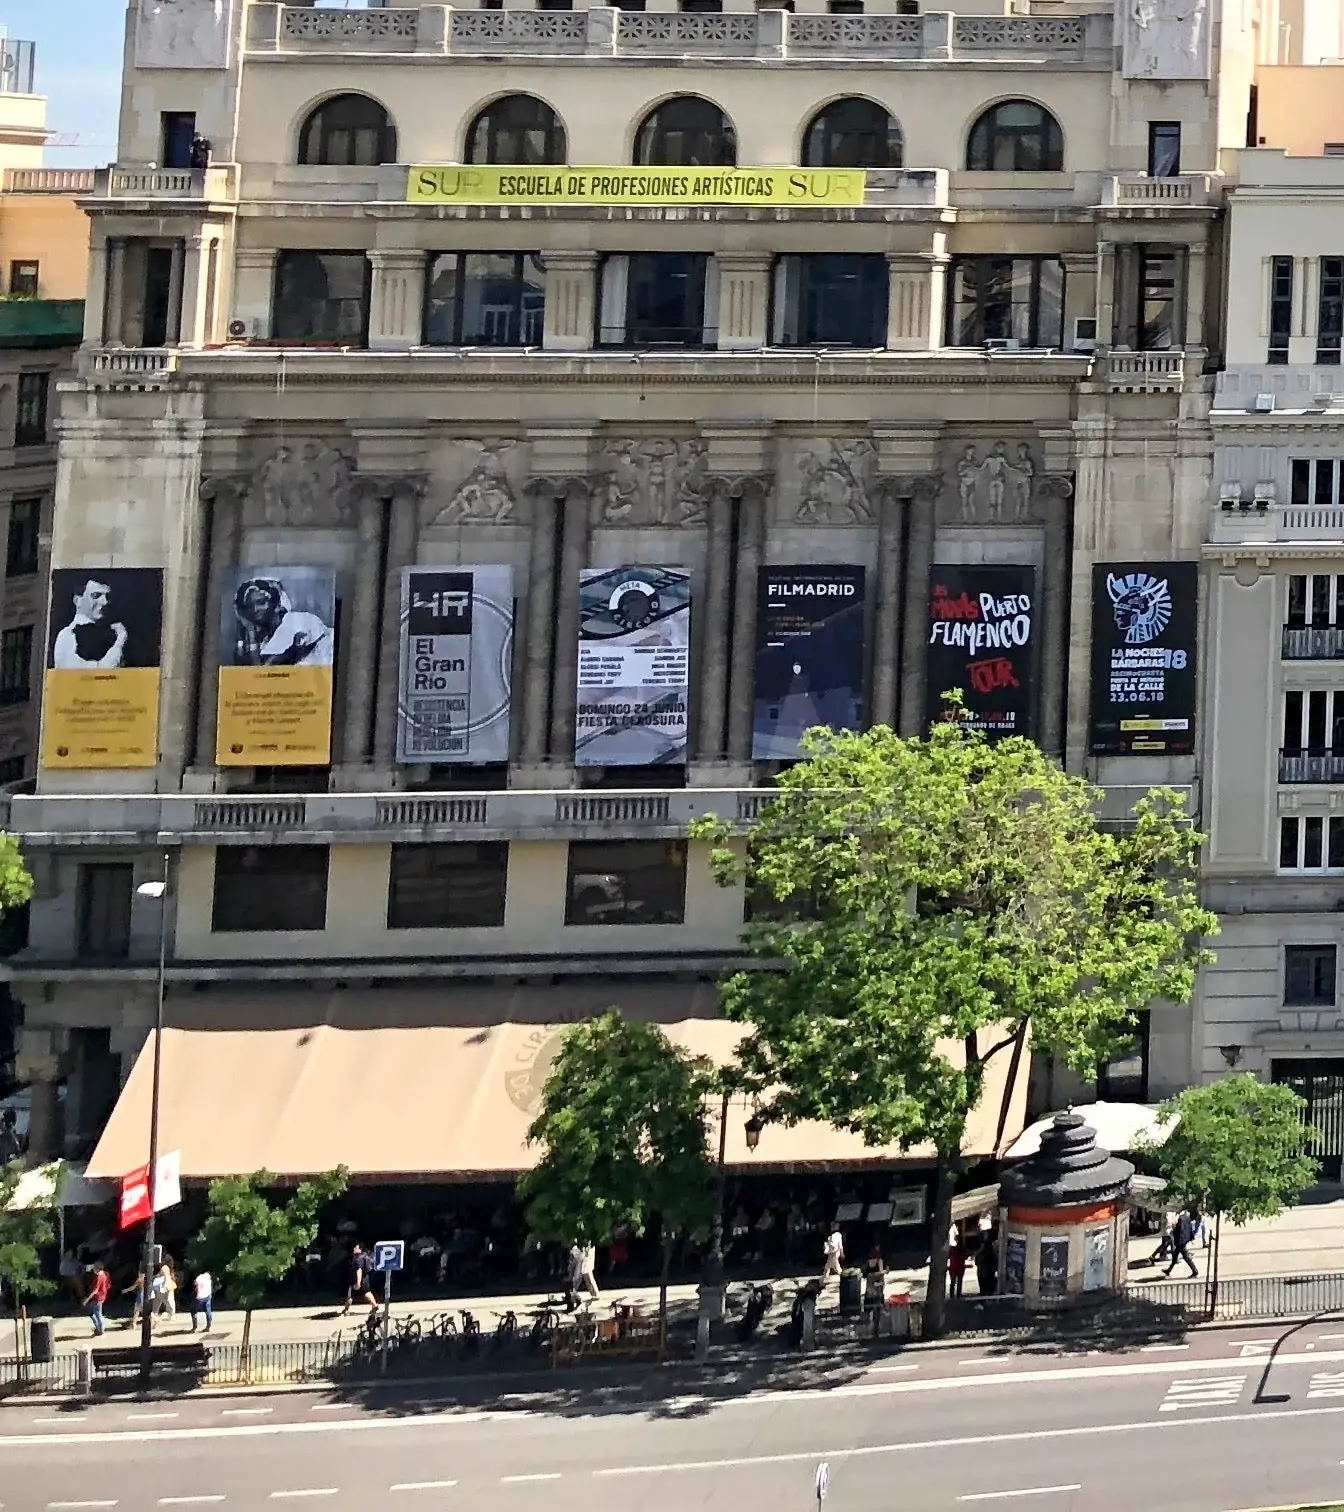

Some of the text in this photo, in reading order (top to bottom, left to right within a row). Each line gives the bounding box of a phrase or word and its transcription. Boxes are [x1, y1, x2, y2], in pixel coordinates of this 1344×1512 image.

[499, 176, 563, 196] ESCUELA
[568, 176, 586, 196] DE
[591, 176, 688, 196] PROFESIONES
[692, 171, 773, 196] ARTÍSTICAS
[788, 173, 852, 198] SUR
[768, 584, 855, 596] FILMADRID
[979, 593, 1030, 622] PUERTO
[930, 615, 1030, 656] FLAMENCO
[416, 638, 434, 655] El
[415, 656, 465, 672] Gran
[1163, 649, 1187, 669] 18
[965, 657, 1020, 694] TOUR
[1123, 683, 1136, 691] LA
[1138, 682, 1165, 691] CALLE
[579, 703, 631, 714] DOMINGO
[652, 703, 685, 714] JUNIO
[579, 716, 618, 727] FIESTA
[377, 1246, 397, 1270] P
